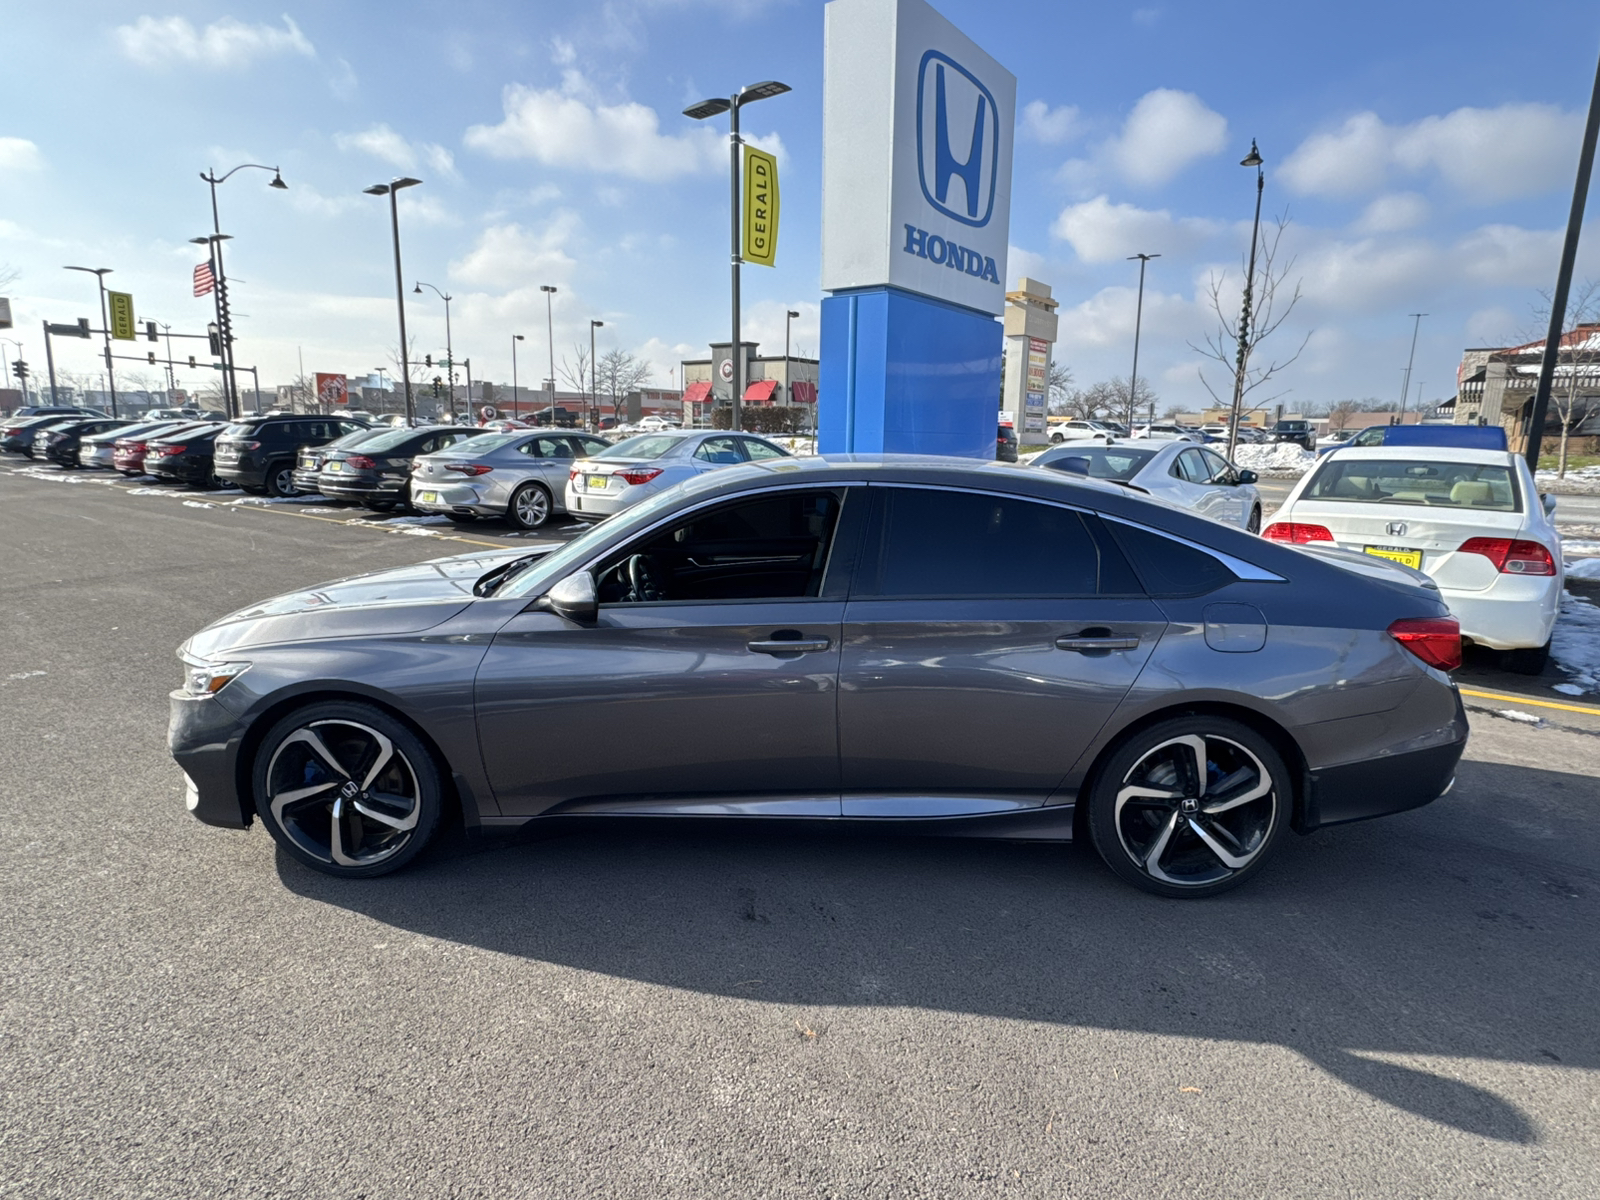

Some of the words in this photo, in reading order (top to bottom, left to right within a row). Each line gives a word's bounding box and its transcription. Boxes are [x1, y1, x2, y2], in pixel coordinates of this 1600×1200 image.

[754, 164, 767, 249] GERALD
[903, 223, 1000, 285] HONDA
[117, 297, 128, 335] GERALD
